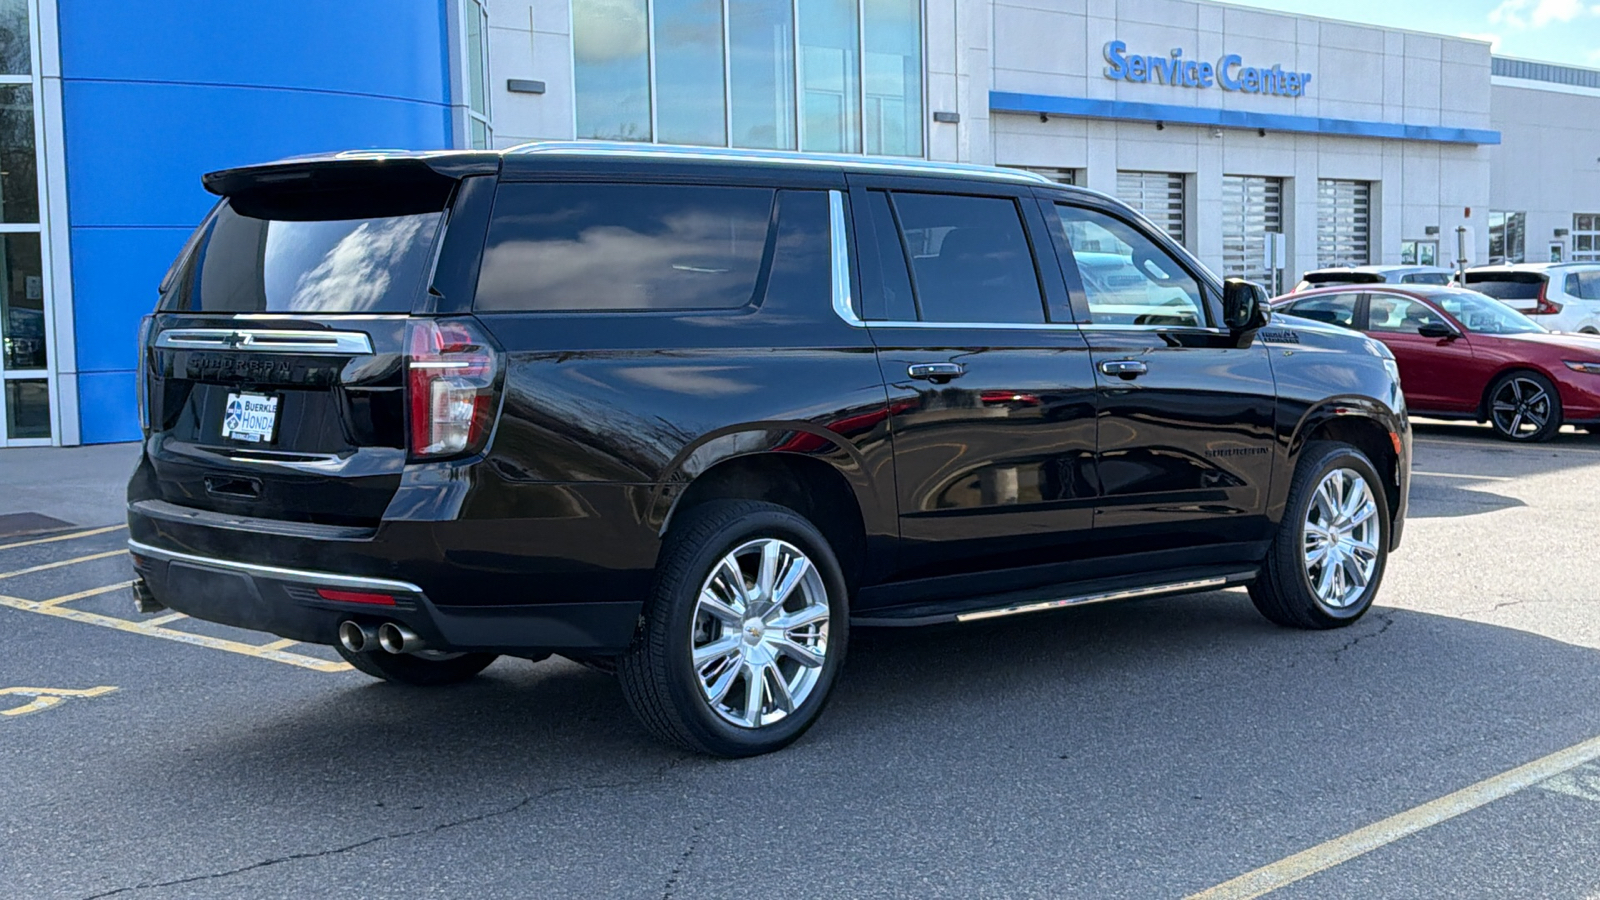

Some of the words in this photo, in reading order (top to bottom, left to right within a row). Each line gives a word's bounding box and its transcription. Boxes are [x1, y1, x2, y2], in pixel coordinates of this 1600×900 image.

[1103, 40, 1214, 88] Service
[1216, 54, 1312, 97] Center
[244, 400, 277, 413] BUERKLE
[242, 411, 273, 430] HONDA
